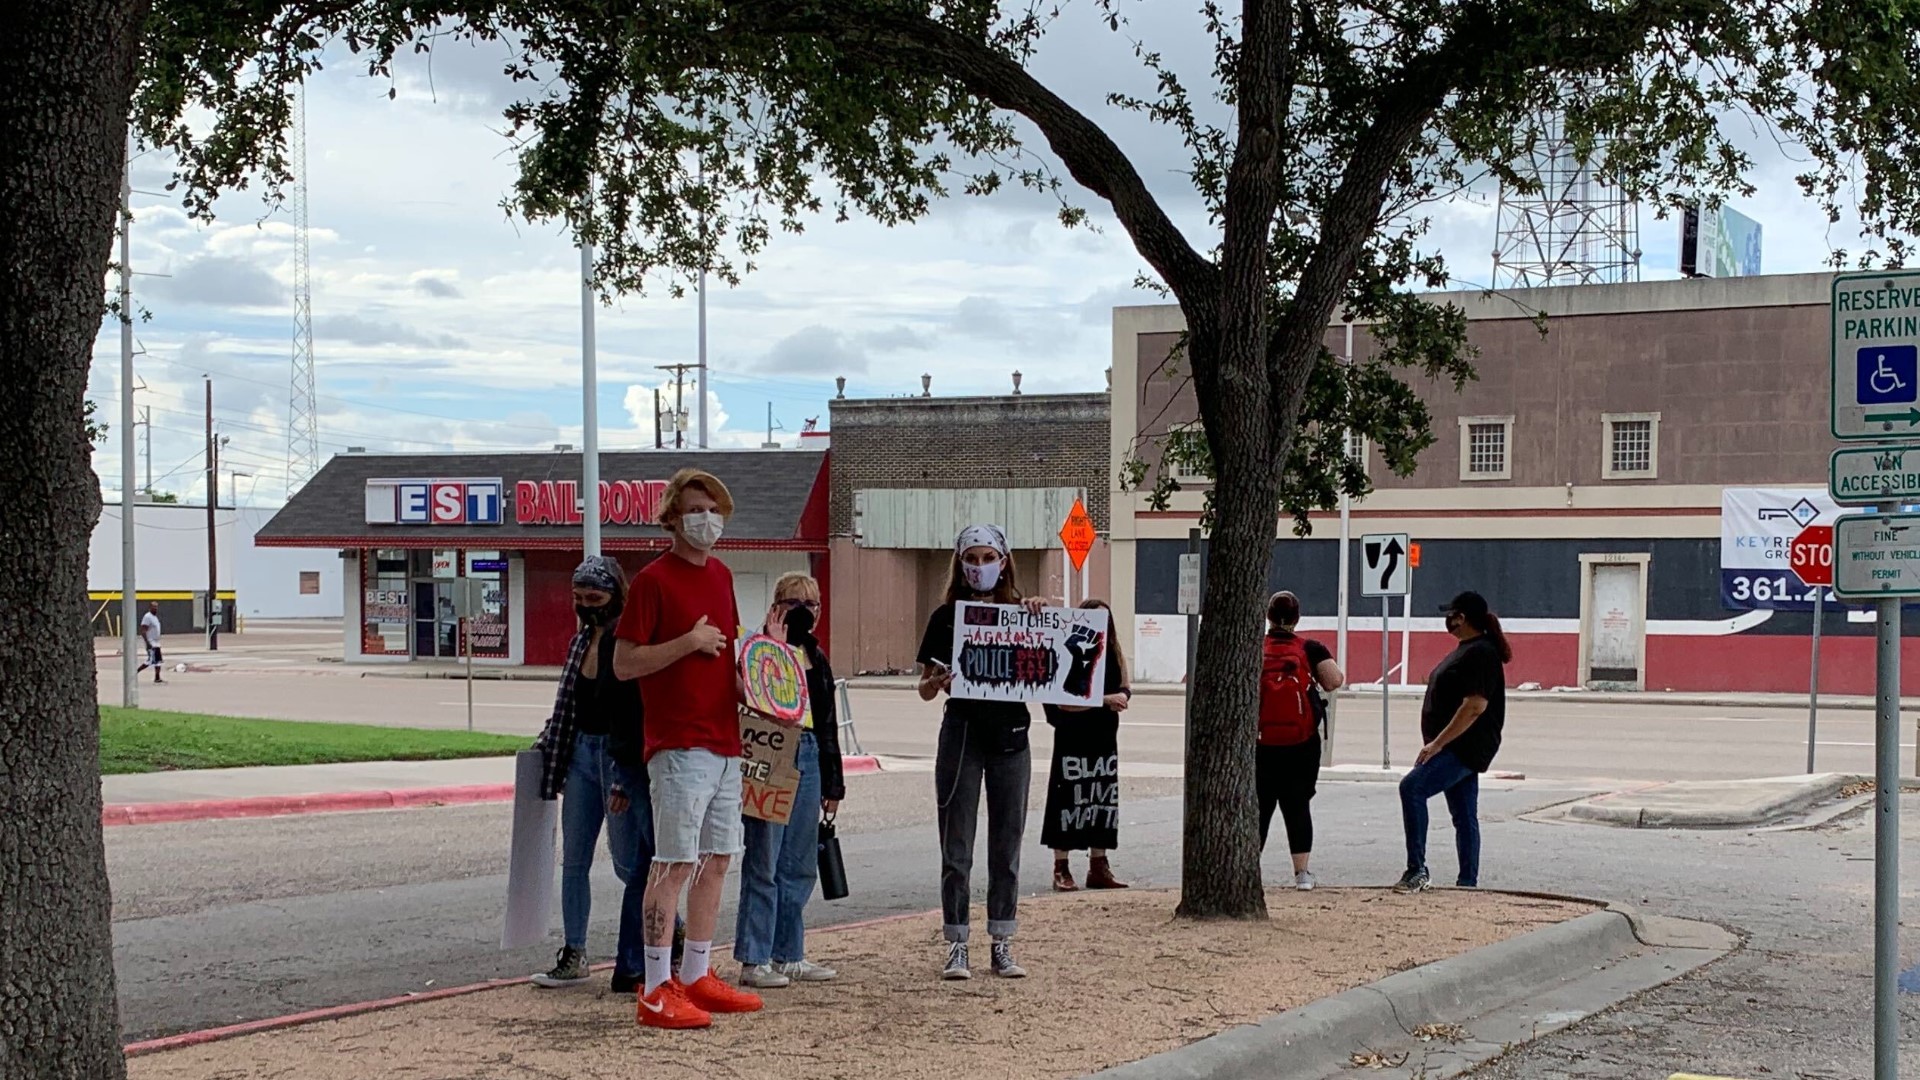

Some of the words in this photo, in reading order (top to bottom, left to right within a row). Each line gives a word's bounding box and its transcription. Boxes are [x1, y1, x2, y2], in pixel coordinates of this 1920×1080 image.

[1873, 455, 1902, 471] VN
[401, 486, 496, 520] EST
[516, 480, 584, 525] BAIL
[1873, 530, 1898, 541] FINE
[1793, 543, 1832, 567] STO
[1852, 551, 1886, 561] WITHOUT
[1872, 569, 1902, 579] PERMIT
[367, 591, 408, 604] BEST
[973, 629, 1044, 644] AGAINST
[966, 648, 1012, 679] POLICE
